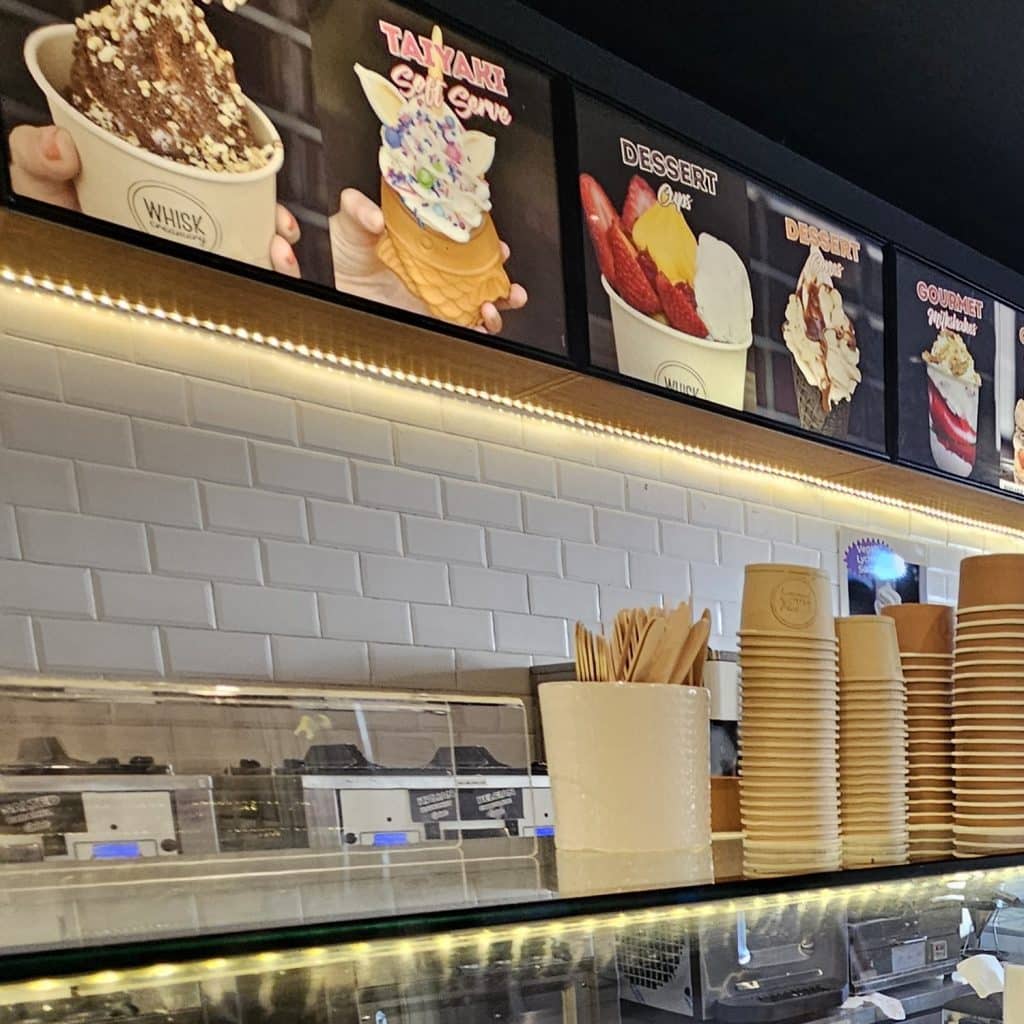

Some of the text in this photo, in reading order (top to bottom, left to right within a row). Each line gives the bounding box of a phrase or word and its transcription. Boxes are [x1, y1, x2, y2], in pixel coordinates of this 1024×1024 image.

[379, 19, 508, 97] TAIYAKI
[448, 85, 513, 126] Serve
[620, 137, 718, 196] DESSERT
[143, 197, 205, 235] WHISK
[785, 216, 860, 263] DESSERT
[916, 281, 984, 319] GOURMET
